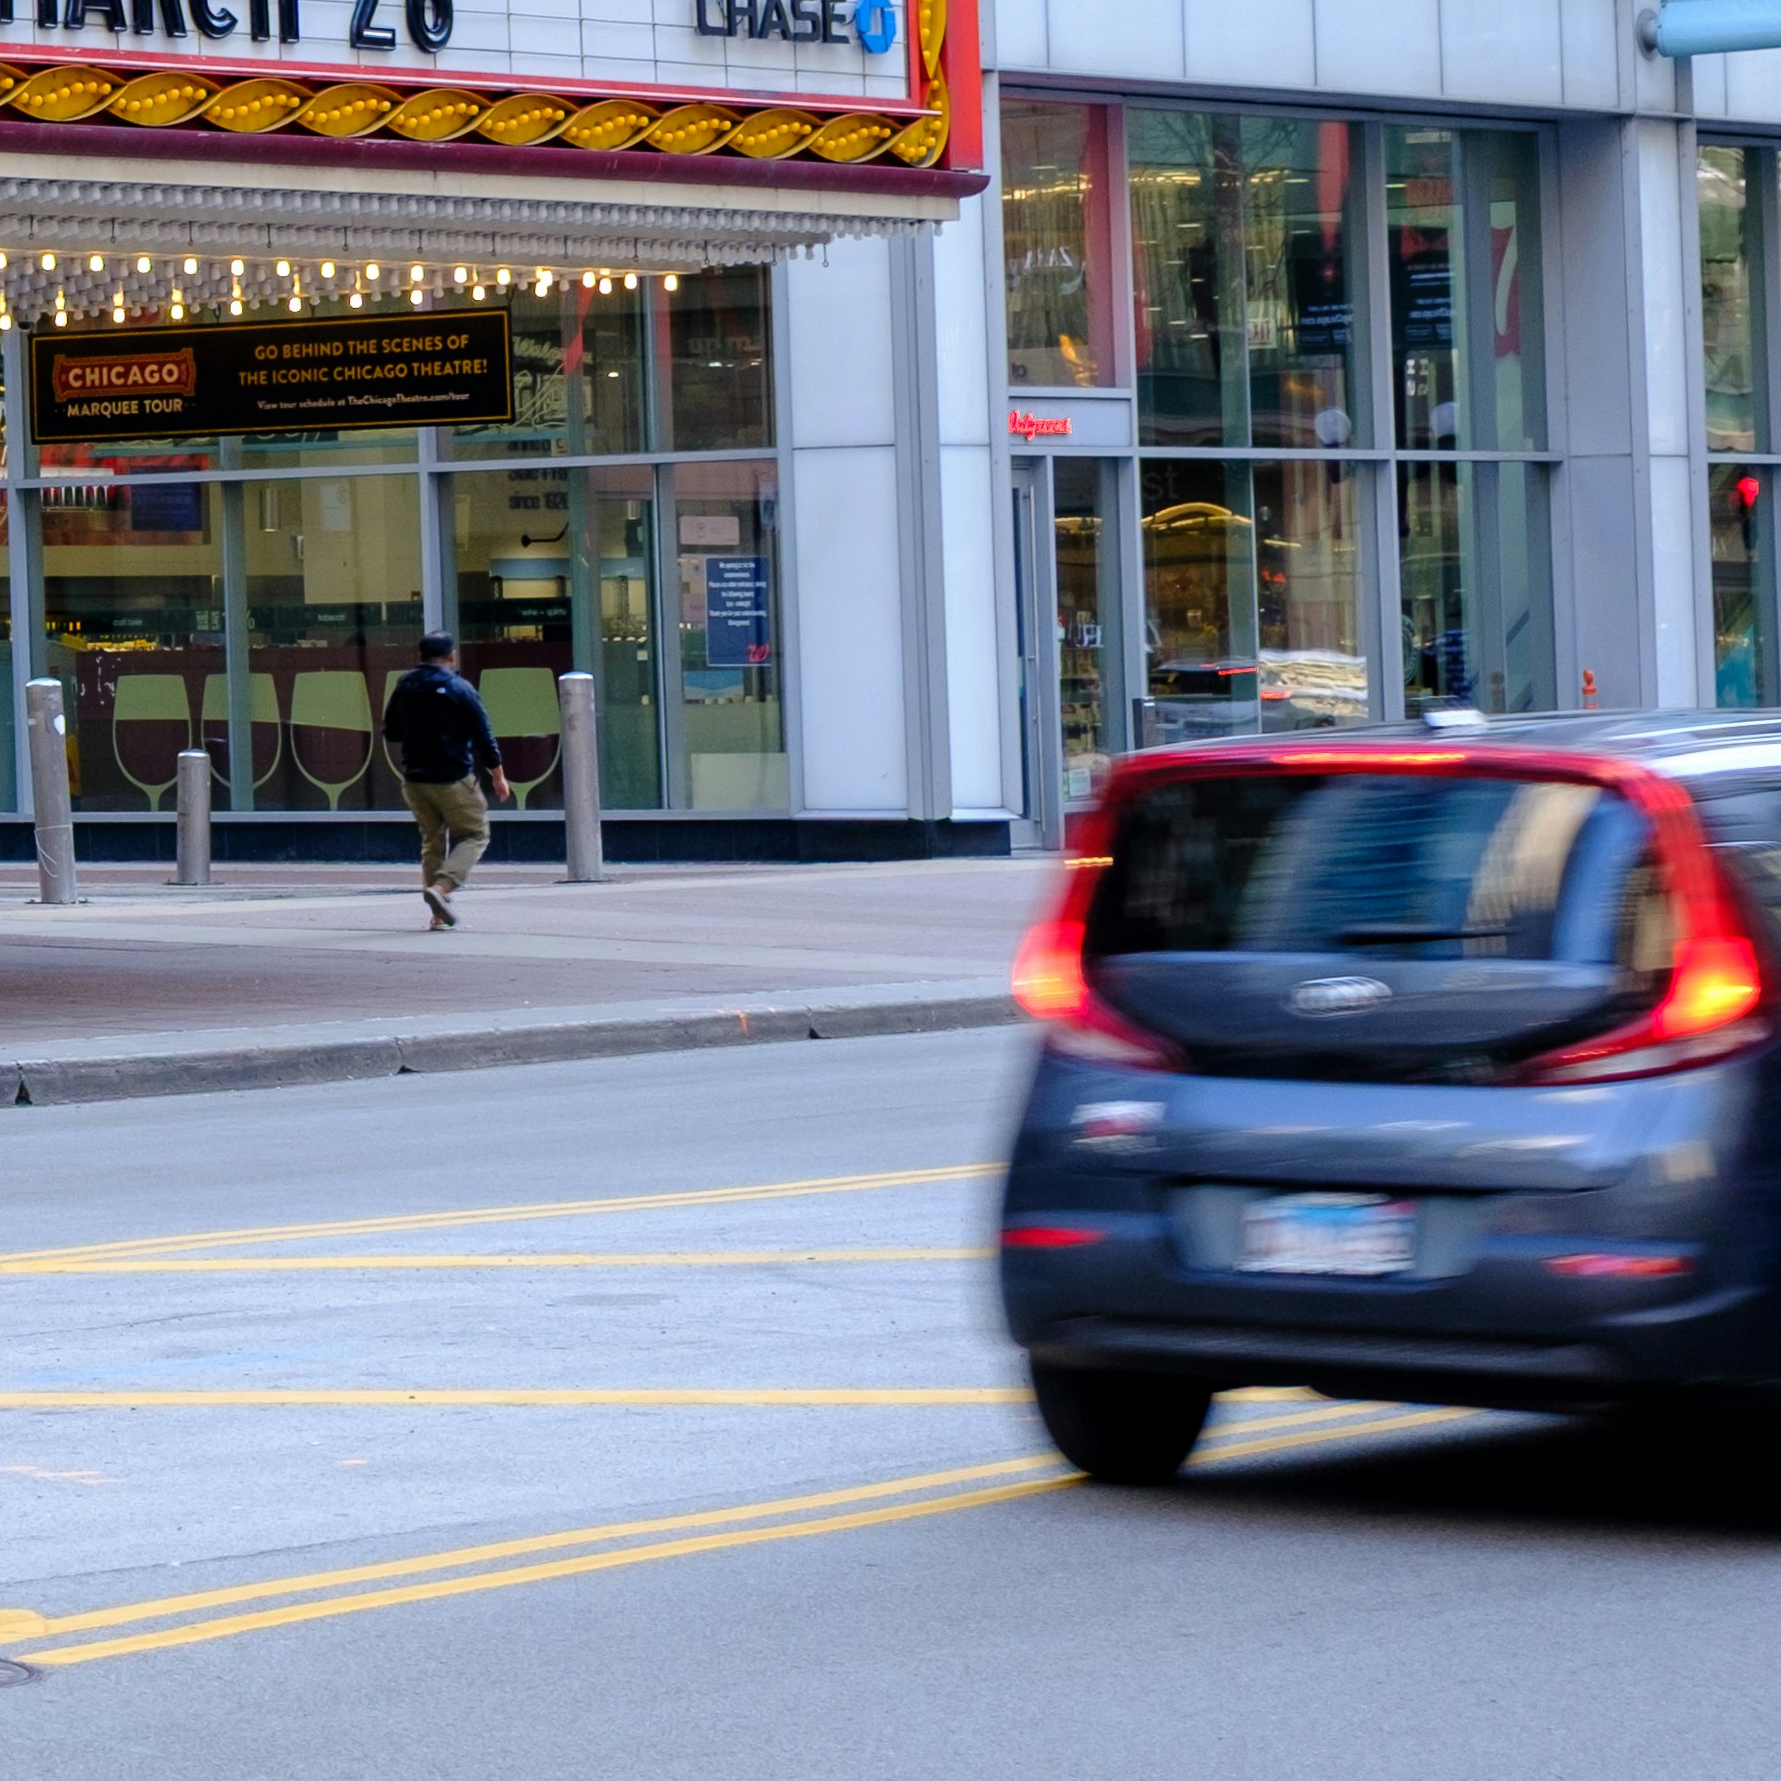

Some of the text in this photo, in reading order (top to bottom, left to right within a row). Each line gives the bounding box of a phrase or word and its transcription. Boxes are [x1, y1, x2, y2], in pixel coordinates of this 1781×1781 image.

[254, 334, 470, 360] GO BEHIND THE SCENES OF
[67, 363, 179, 387] CHICAGO
[239, 359, 488, 386] THE ICONIC CHICAGO THEATRE!
[67, 398, 183, 417] MARQUEE TOUR
[257, 400, 277, 409] View
[279, 401, 297, 409] tour
[299, 398, 335, 408] schedule
[337, 396, 346, 406] at
